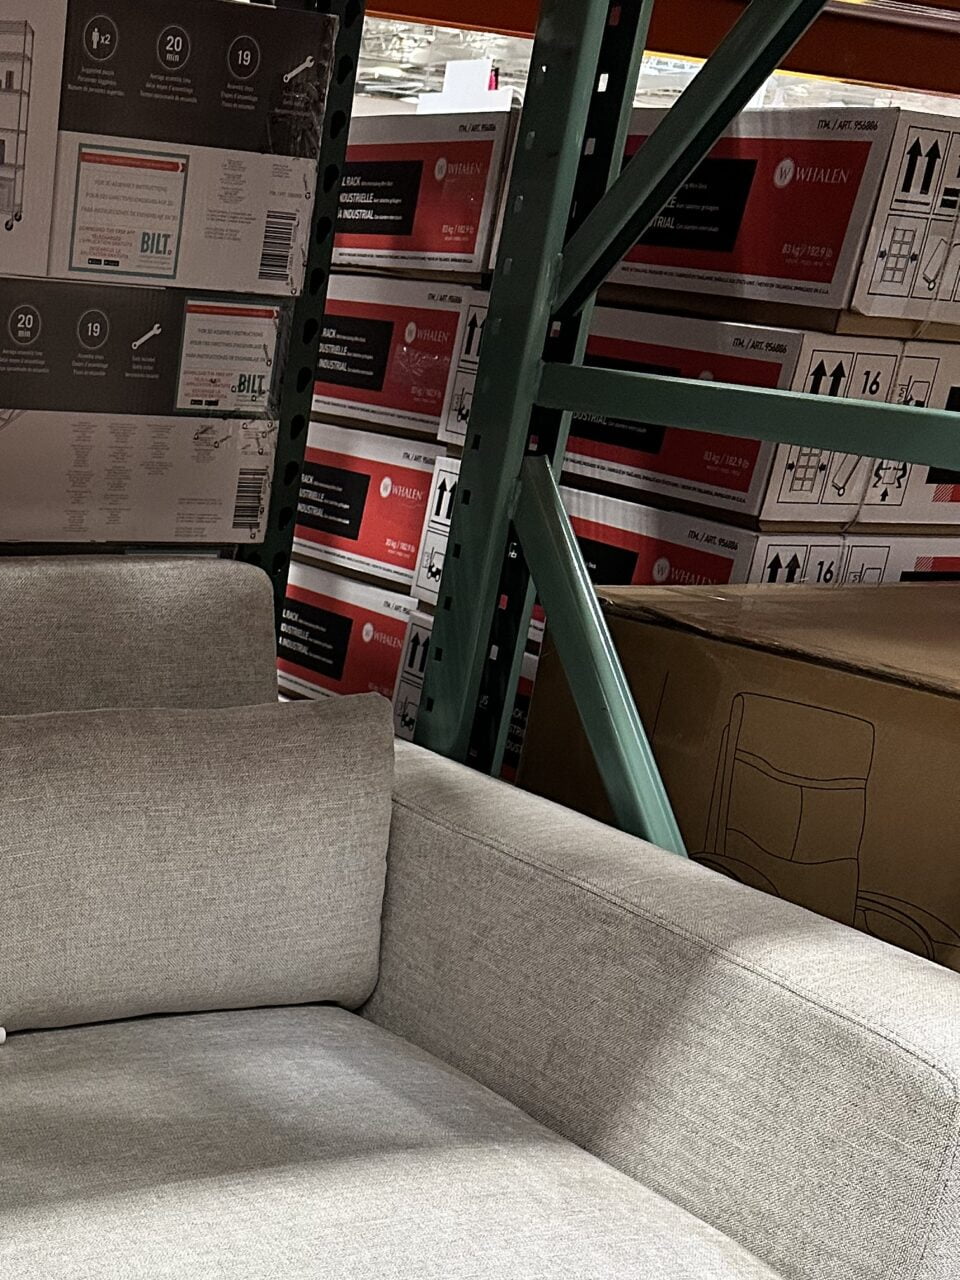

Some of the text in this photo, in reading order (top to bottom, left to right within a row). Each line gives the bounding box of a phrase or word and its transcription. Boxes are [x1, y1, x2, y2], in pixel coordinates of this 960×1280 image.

[100, 34, 111, 45] x2
[165, 35, 183, 52] 20
[166, 52, 180, 62] min
[237, 50, 251, 65] 19
[795, 167, 850, 184] WHALEN
[17, 313, 33, 329] 20
[87, 322, 100, 337] 19
[417, 328, 449, 343] WHALEN
[863, 370, 882, 395] 16
[392, 483, 423, 501] WHALEN
[817, 560, 834, 583] 16
